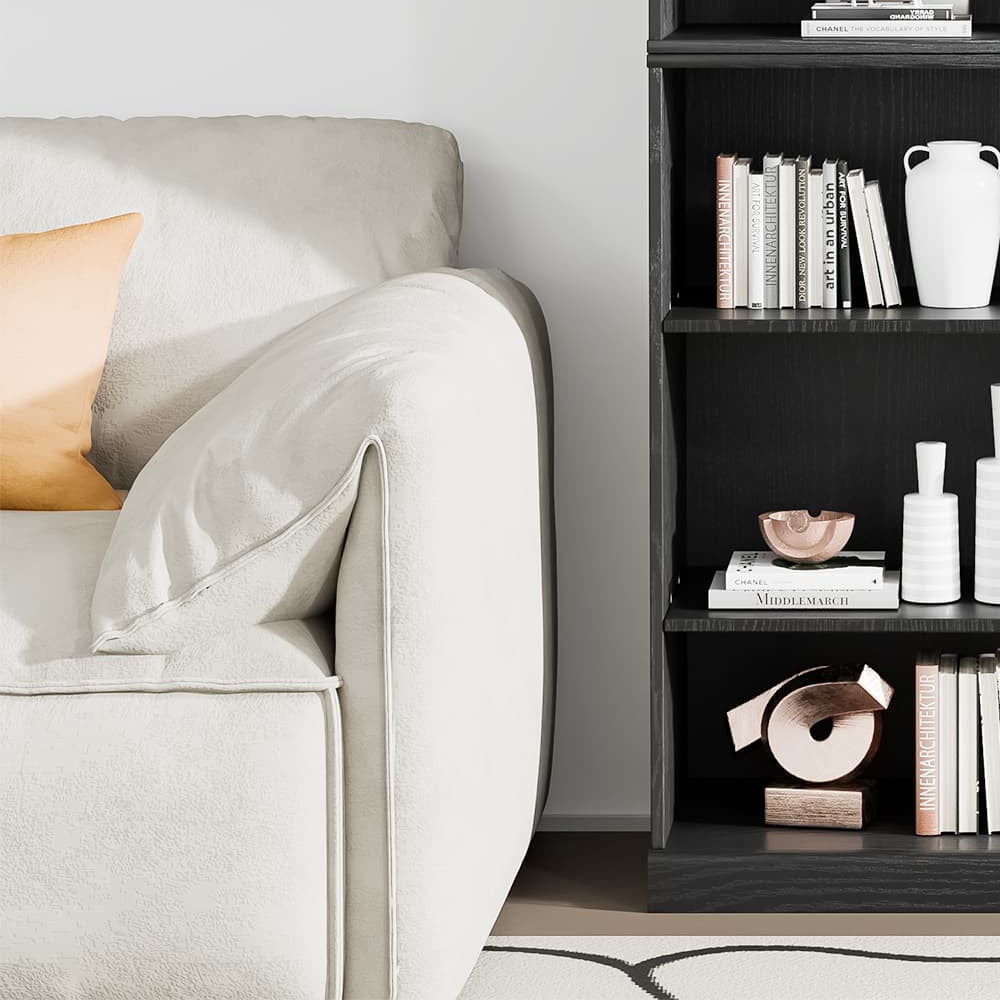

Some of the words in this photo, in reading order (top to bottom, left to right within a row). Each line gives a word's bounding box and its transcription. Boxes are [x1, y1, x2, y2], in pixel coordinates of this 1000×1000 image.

[751, 182, 761, 198] ART
[838, 172, 847, 189] ART
[751, 199, 761, 216] FOR
[823, 182, 835, 225] urban
[840, 190, 848, 209] FOR
[765, 166, 777, 287] INNENARCHITEKTUR
[718, 178, 732, 302] INNENARCHITEKTUR
[751, 218, 761, 256] SURVIVAL
[825, 230, 835, 247] an
[823, 251, 835, 265] in
[824, 269, 835, 289] art
[919, 674, 937, 811] INNENARCHITEKTUR
